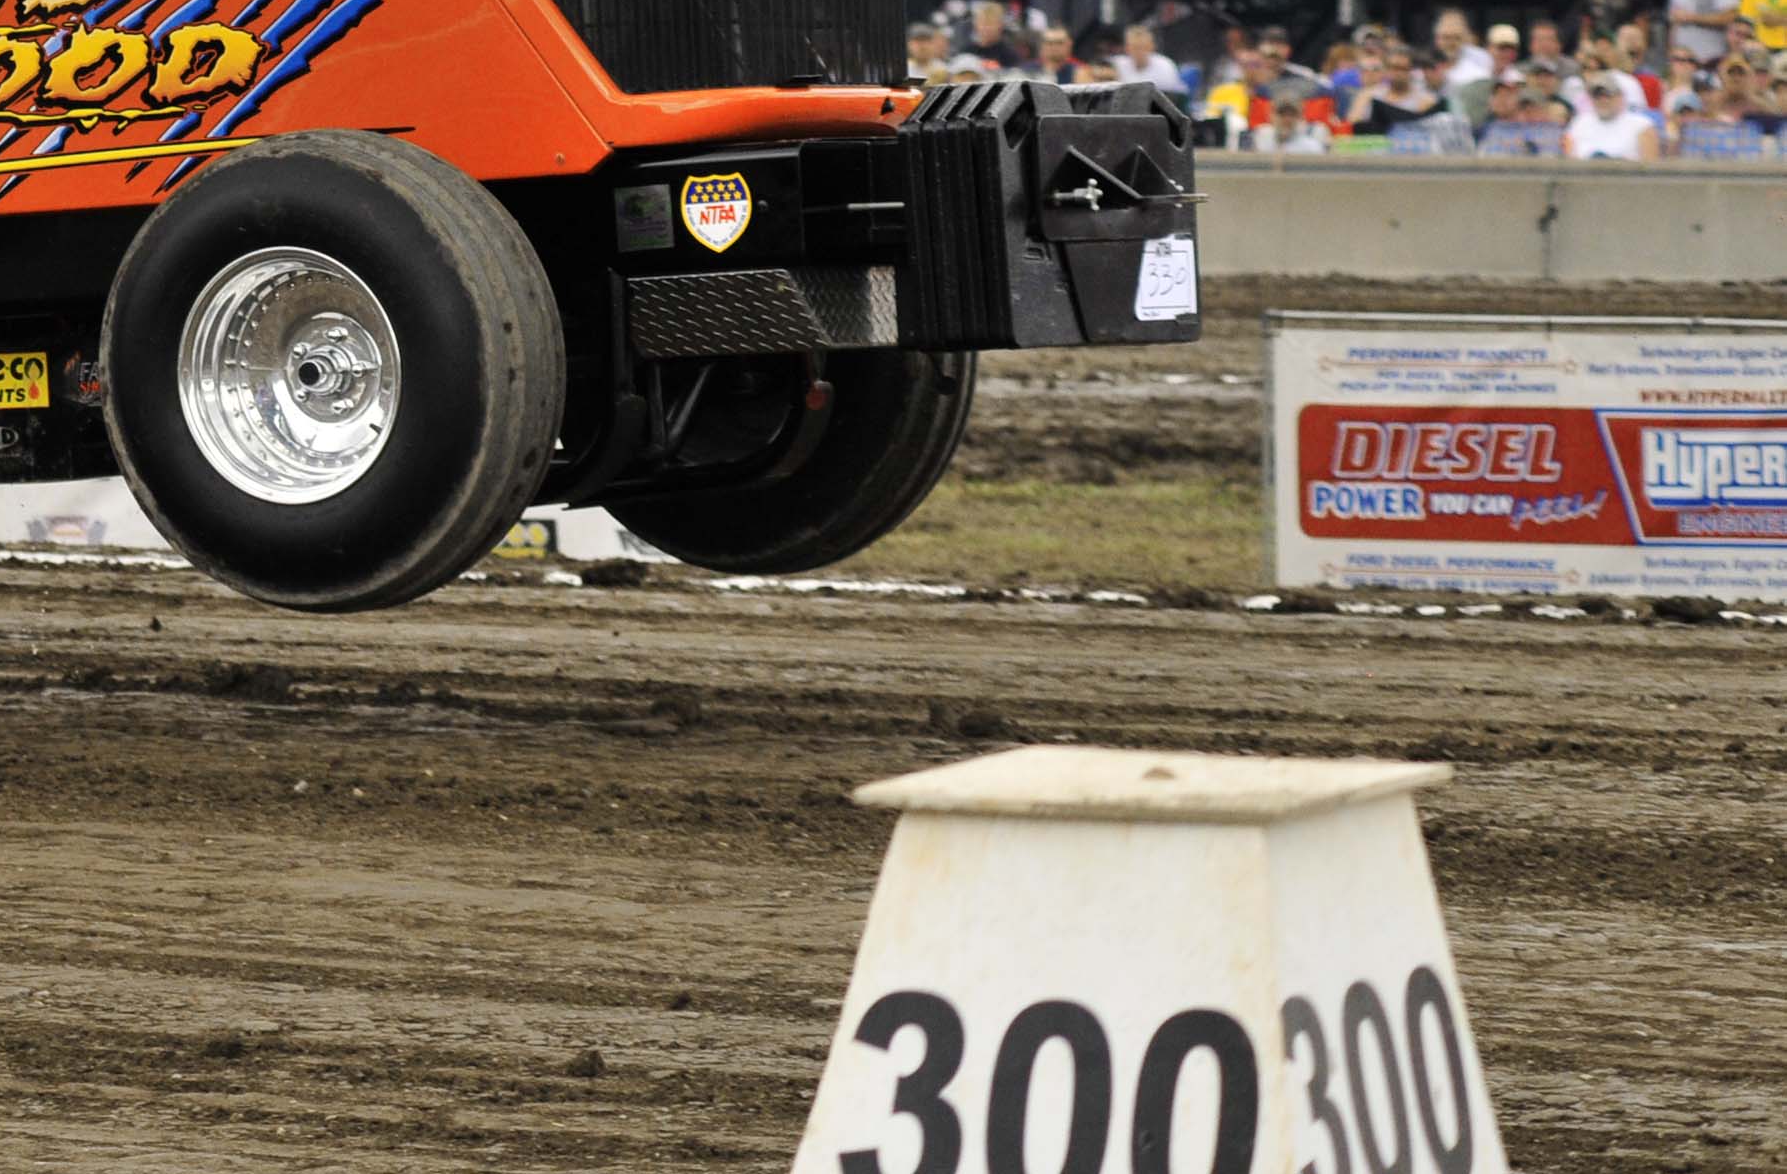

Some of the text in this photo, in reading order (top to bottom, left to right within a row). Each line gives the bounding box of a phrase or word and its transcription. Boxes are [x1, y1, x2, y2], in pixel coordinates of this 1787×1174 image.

[699, 204, 737, 225] NTPA
[1148, 262, 1188, 298] 330
[1333, 421, 1562, 482] DIESEL
[1309, 481, 1426, 520] POWER
[1429, 492, 1469, 515] YOU
[1470, 493, 1513, 516] CAN
[839, 965, 1474, 1174] 300 300
